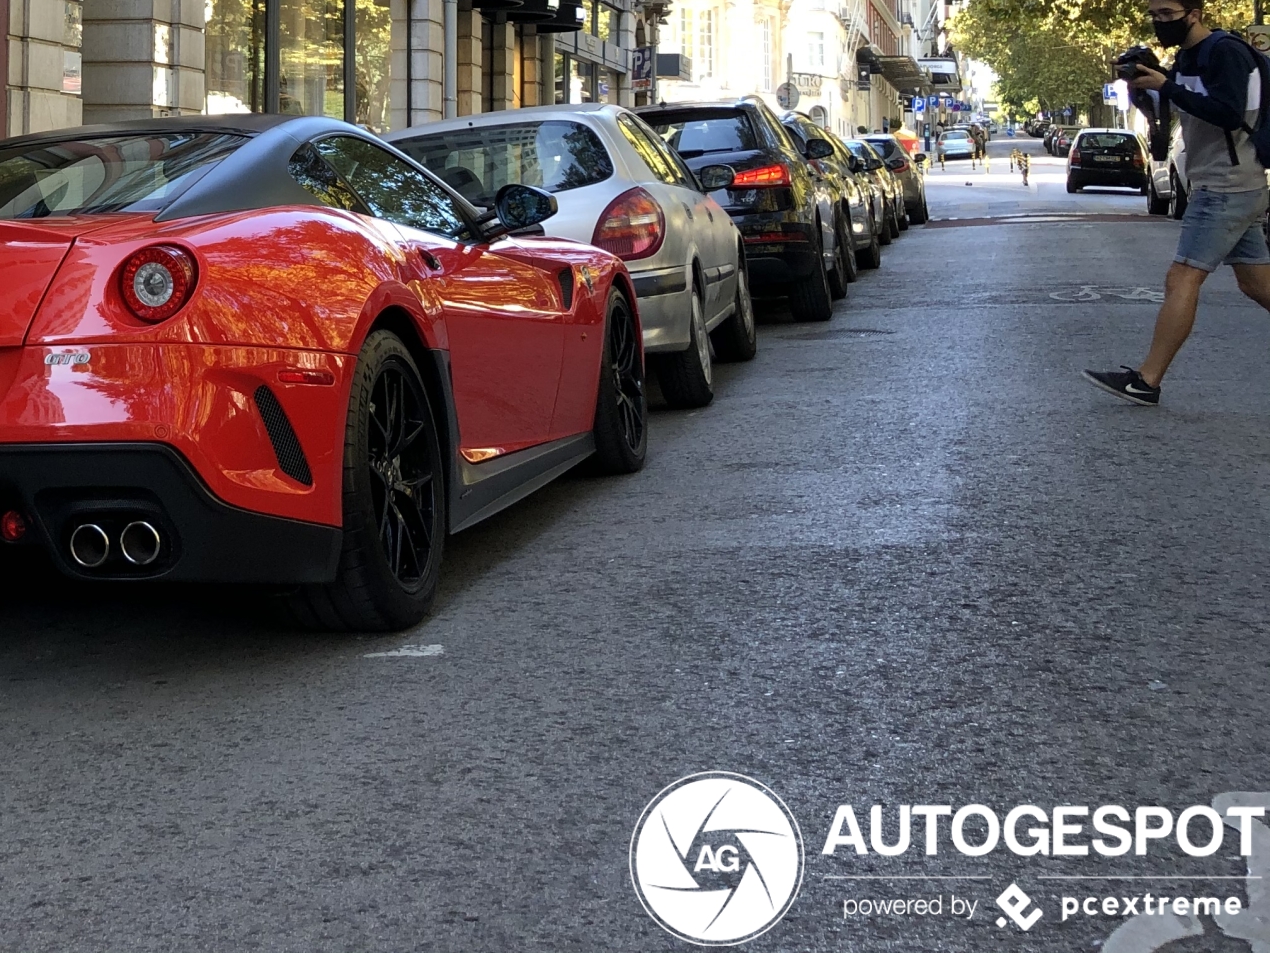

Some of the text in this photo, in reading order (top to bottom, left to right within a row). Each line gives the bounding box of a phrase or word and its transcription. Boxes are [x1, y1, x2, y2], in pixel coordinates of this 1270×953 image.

[915, 99, 923, 110] P
[929, 96, 936, 105] P
[946, 99, 952, 107] P
[44, 353, 92, 365] GTO
